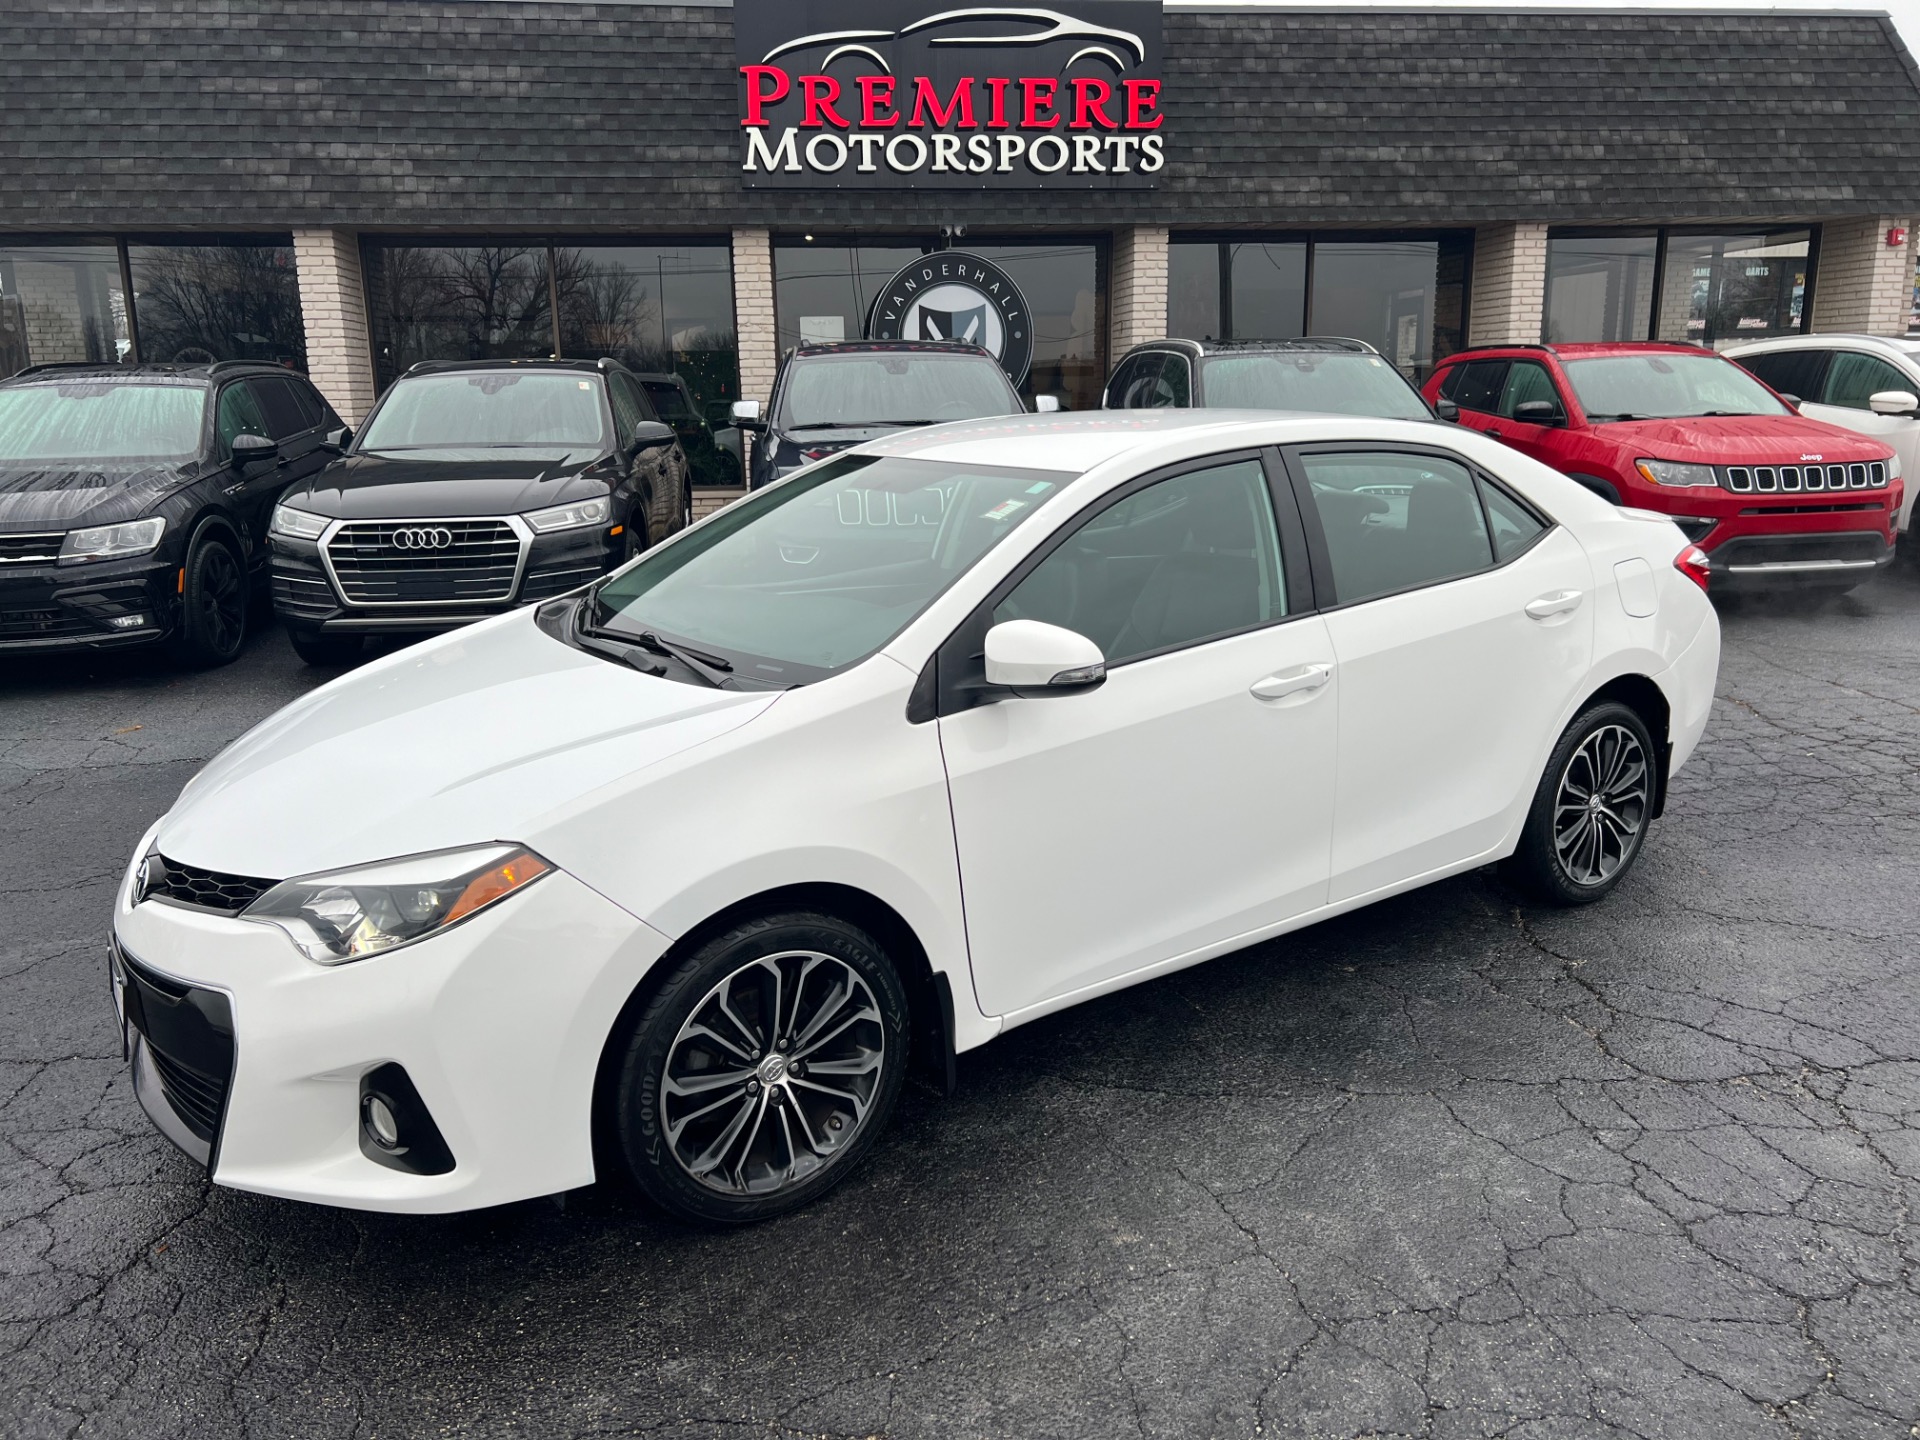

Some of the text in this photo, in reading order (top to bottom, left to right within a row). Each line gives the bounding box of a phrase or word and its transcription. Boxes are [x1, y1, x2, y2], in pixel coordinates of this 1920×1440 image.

[740, 65, 1164, 129] PREMIERE
[742, 127, 1165, 173] MOTORSPORTS
[884, 263, 1019, 321] VANDERHALL
[1800, 453, 1823, 462] Jeep
